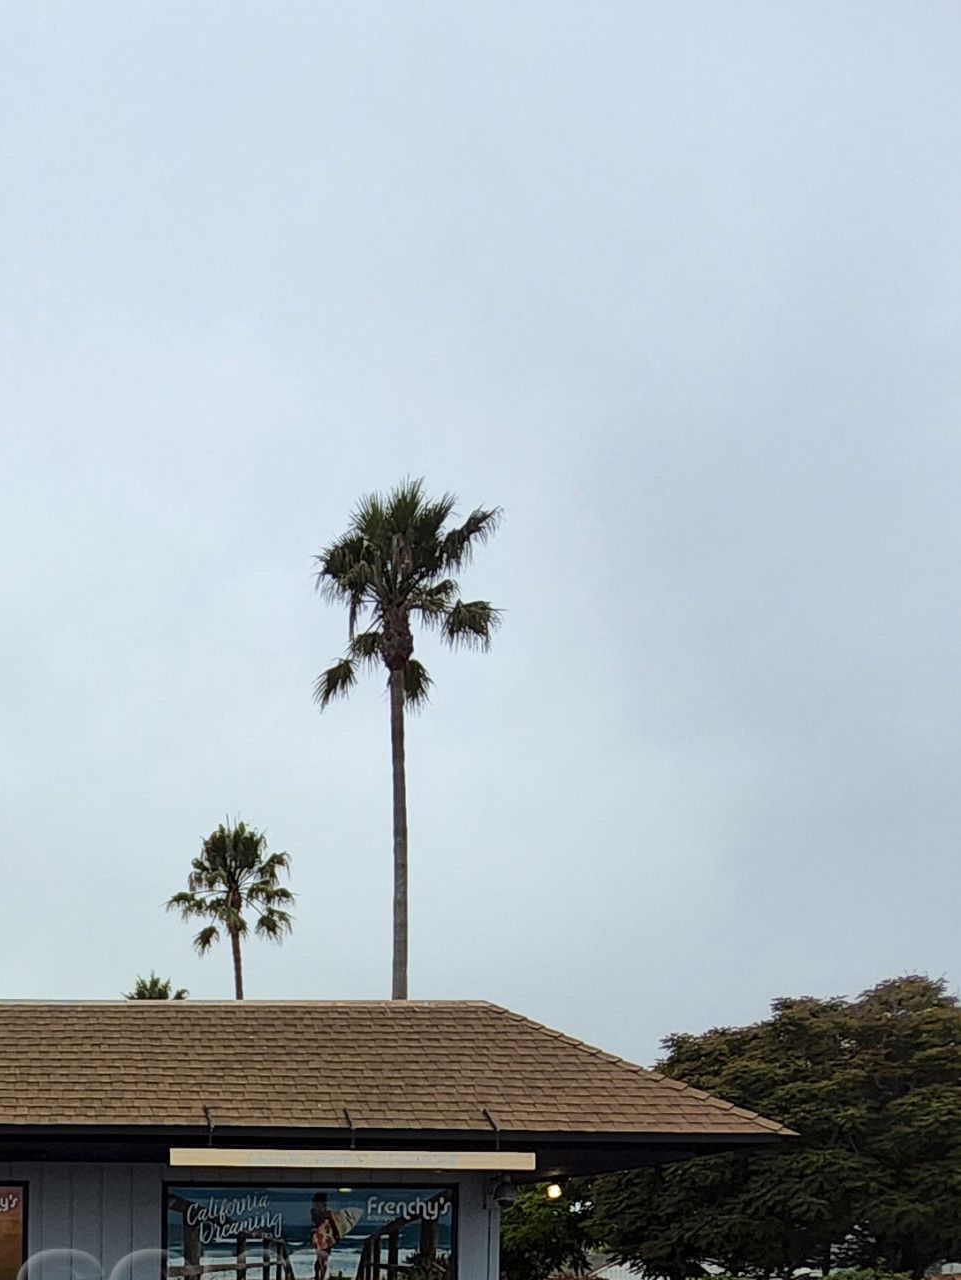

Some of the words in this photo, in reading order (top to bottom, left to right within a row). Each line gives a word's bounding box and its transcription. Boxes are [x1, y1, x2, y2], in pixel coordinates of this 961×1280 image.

[186, 1192, 270, 1226] California
[367, 1196, 452, 1221] Frenchy's
[198, 1212, 285, 1245] Dreaming
